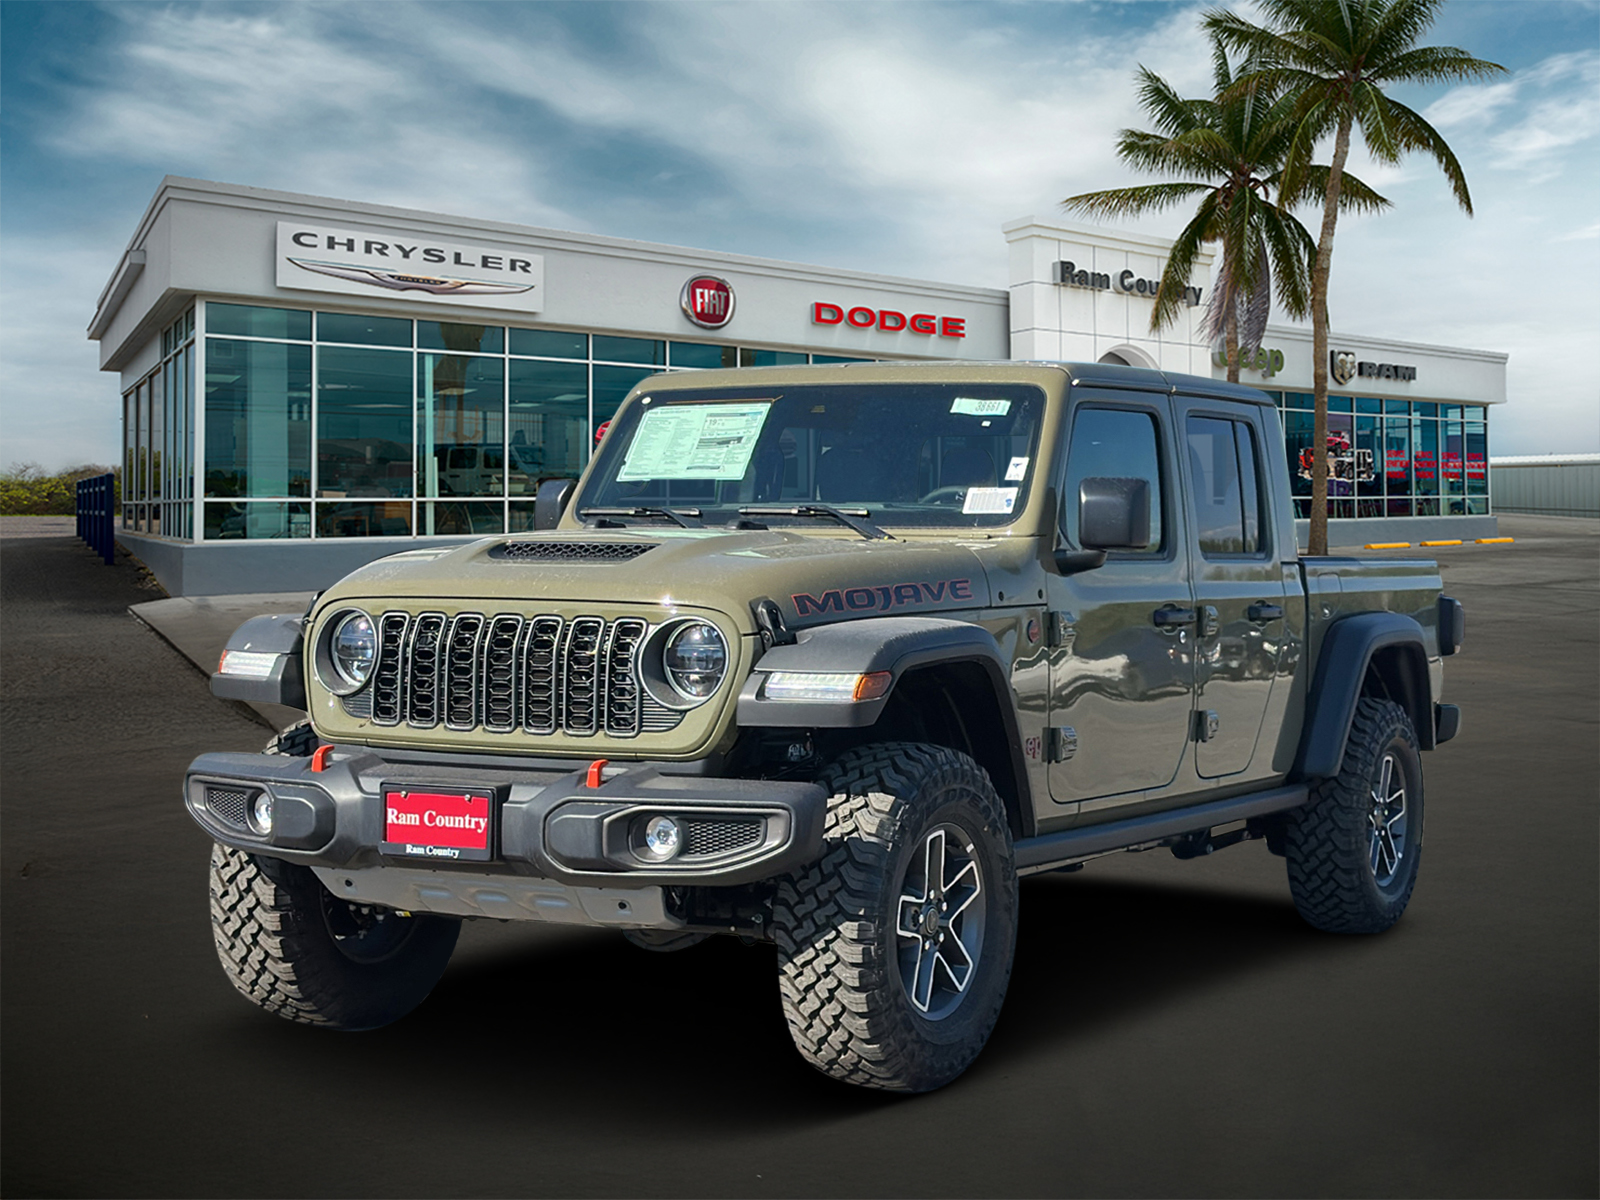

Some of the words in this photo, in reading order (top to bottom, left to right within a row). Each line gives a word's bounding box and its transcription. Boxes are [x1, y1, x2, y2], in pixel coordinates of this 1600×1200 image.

[292, 232, 532, 273] CHRYSLER
[1053, 260, 1111, 291] Ram
[695, 287, 728, 316] FIAT
[811, 301, 966, 338] DODGE
[1357, 361, 1417, 381] RAM
[791, 579, 973, 616] MOJAVE
[387, 808, 420, 826] Ram
[424, 810, 487, 833] Country
[406, 844, 424, 855] Ram
[426, 846, 460, 859] Country
